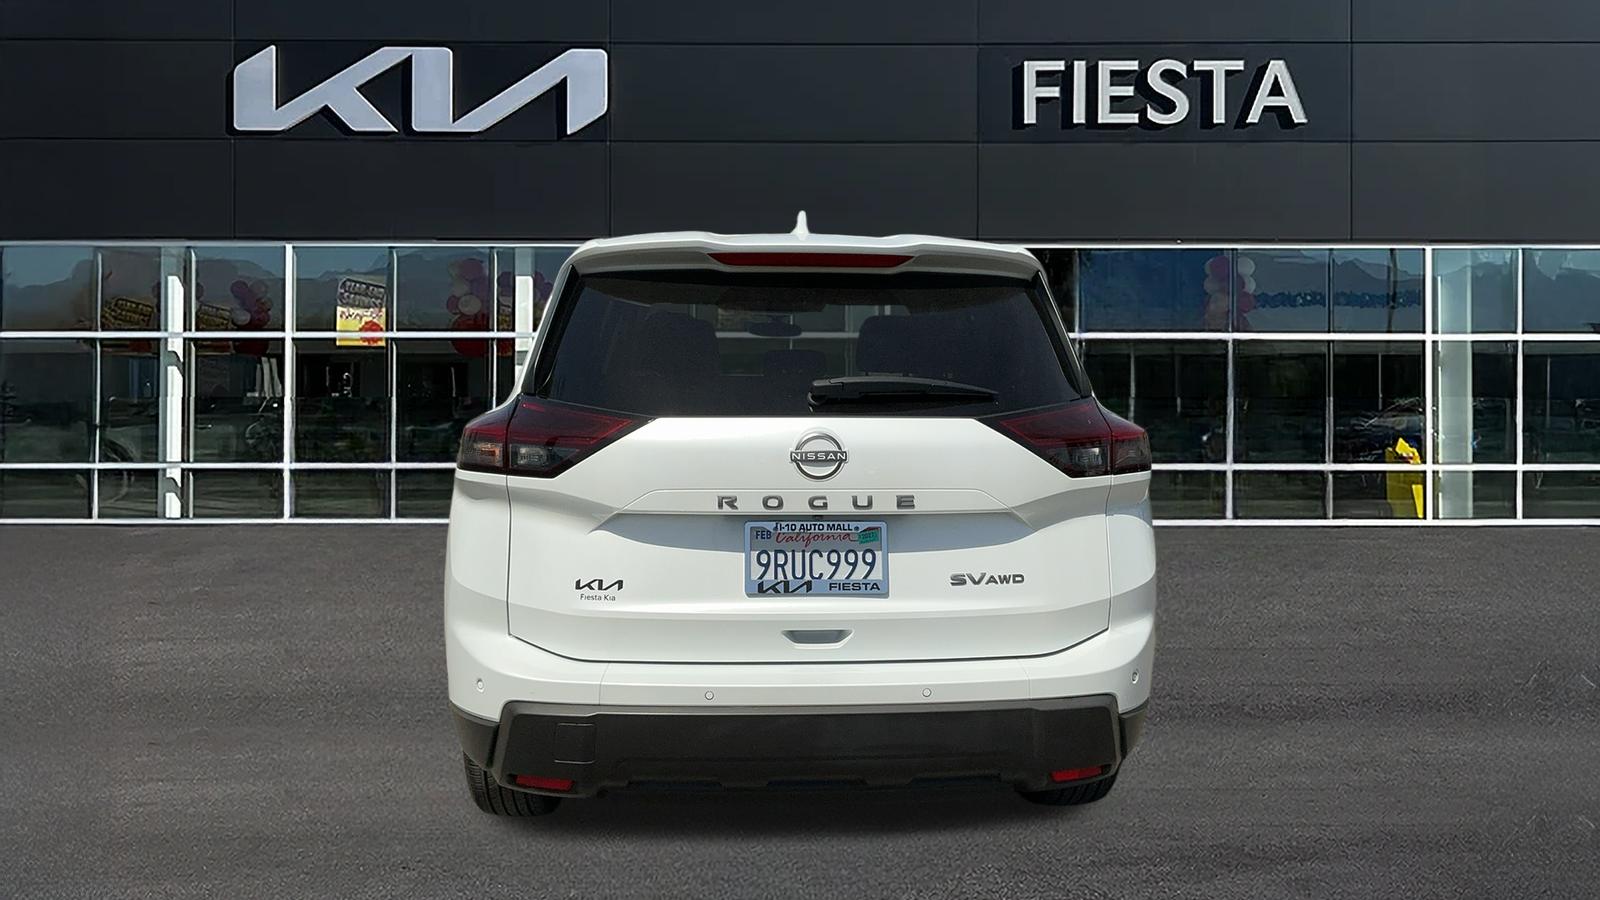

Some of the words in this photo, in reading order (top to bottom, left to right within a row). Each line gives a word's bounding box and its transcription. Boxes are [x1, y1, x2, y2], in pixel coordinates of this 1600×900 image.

[1022, 58, 1308, 125] FIESTA
[791, 451, 847, 461] NISSAN
[717, 495, 916, 511] ROGUE
[799, 523, 824, 532] AUTO
[826, 523, 853, 532] MALL
[755, 530, 772, 540] FEB
[775, 532, 851, 547] California
[756, 549, 877, 580] 9RUC999
[829, 582, 881, 591] FIESTA
[580, 593, 602, 601] Fiesta
